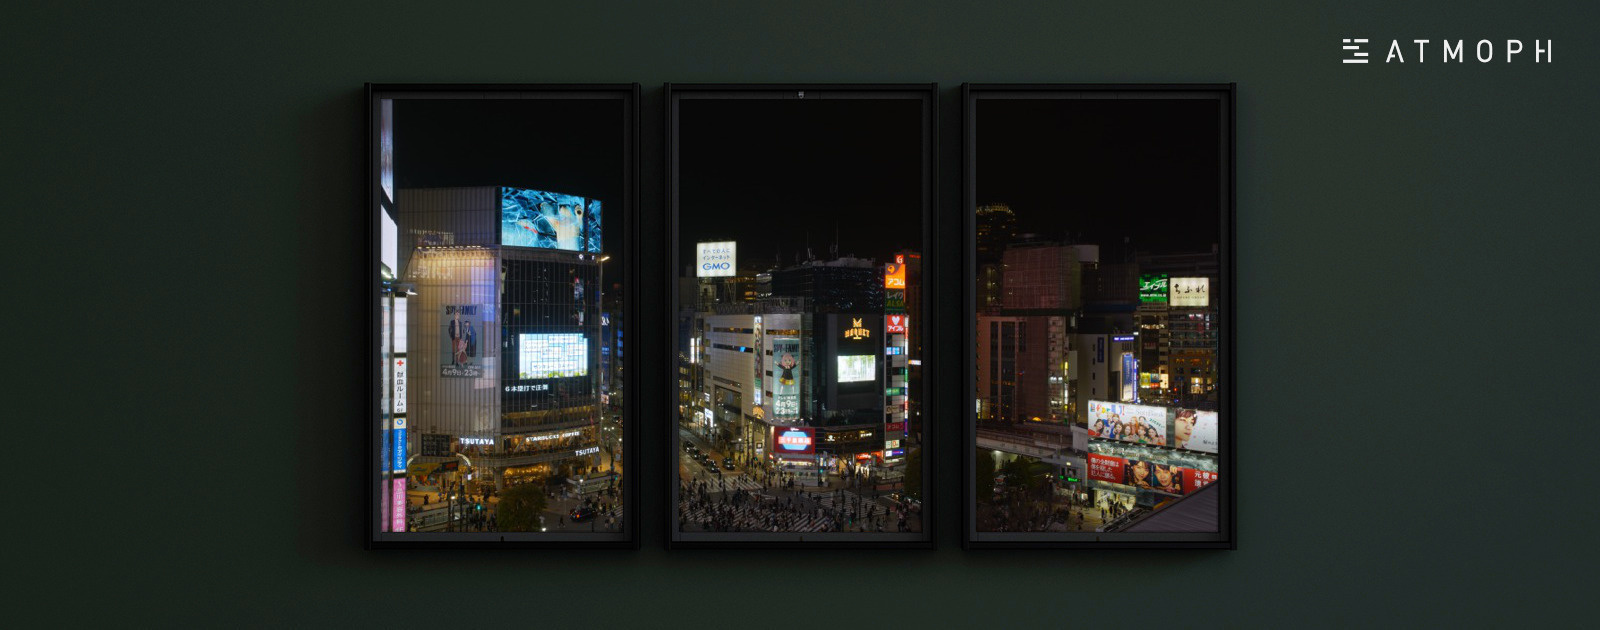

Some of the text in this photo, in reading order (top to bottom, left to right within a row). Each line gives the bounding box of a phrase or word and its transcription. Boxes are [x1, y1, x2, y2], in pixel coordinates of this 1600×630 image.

[702, 262, 731, 270] GMO
[887, 278, 905, 286] アコム
[1174, 283, 1205, 294] ちふれ
[460, 437, 495, 446] TSUTAYA
[575, 446, 600, 457] TSUTAYA
